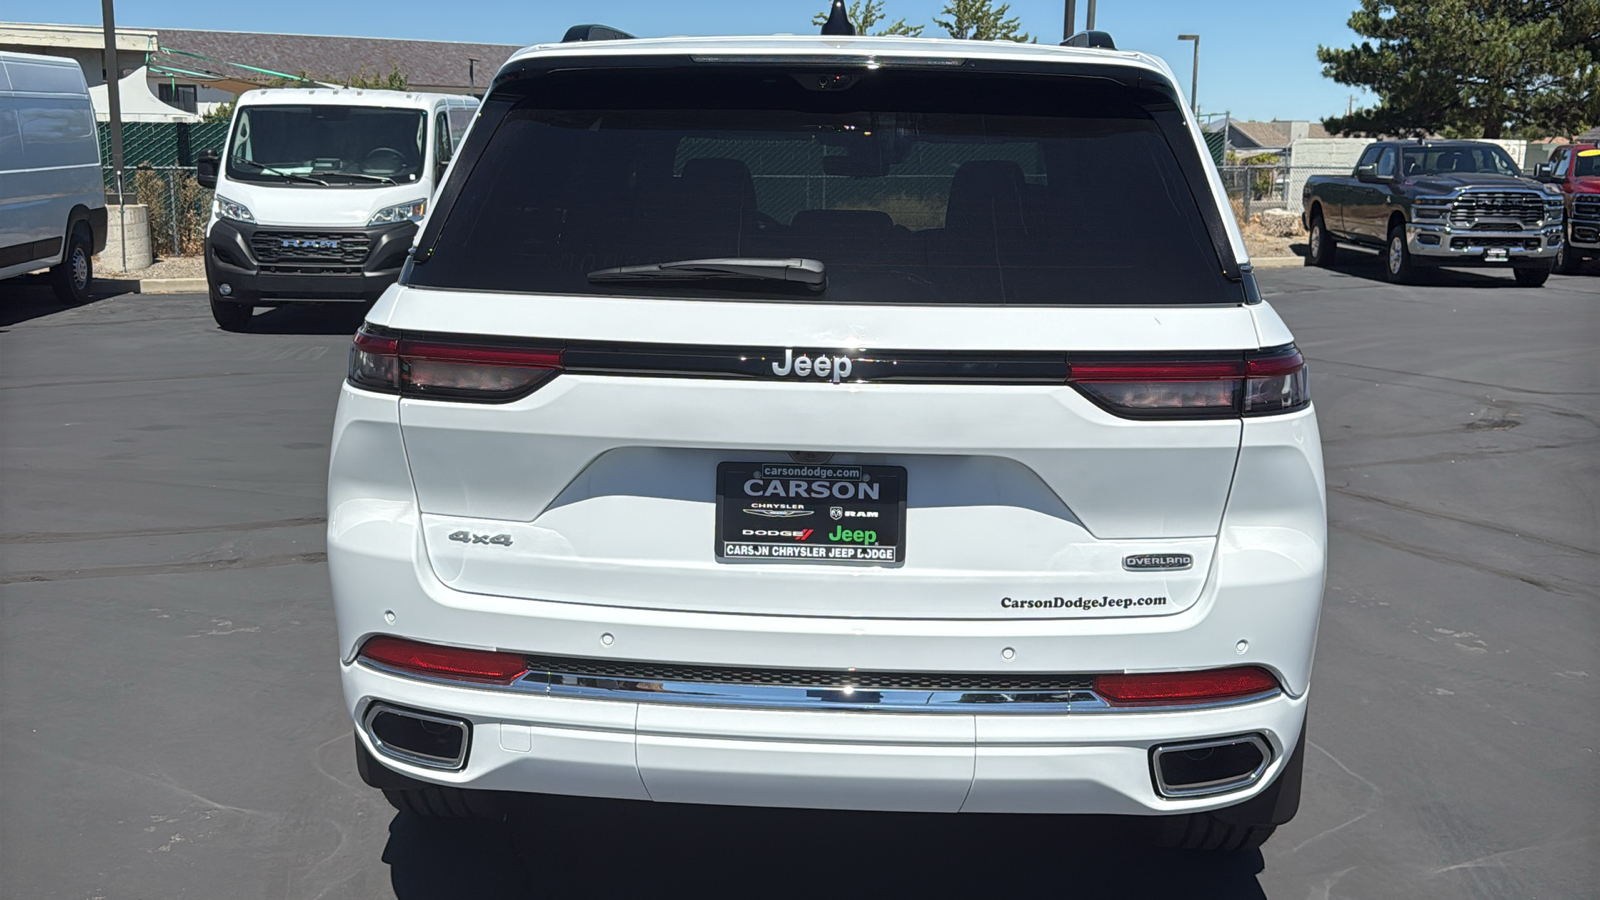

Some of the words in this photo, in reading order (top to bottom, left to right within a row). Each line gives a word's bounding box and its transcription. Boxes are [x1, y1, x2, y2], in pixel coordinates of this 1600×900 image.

[281, 239, 338, 248] RAM
[772, 349, 852, 384] Jeep
[764, 466, 860, 478] carsondodge.com
[743, 479, 880, 500] CARSON
[448, 530, 513, 547] 4x4
[742, 529, 804, 537] DODGE
[828, 525, 877, 545] Jeep
[771, 546, 826, 558] CHRYSLER
[828, 547, 855, 558] JEEP
[1126, 556, 1191, 566] OVERLAND
[1001, 597, 1167, 610] CarsonDodgeJeep.com
